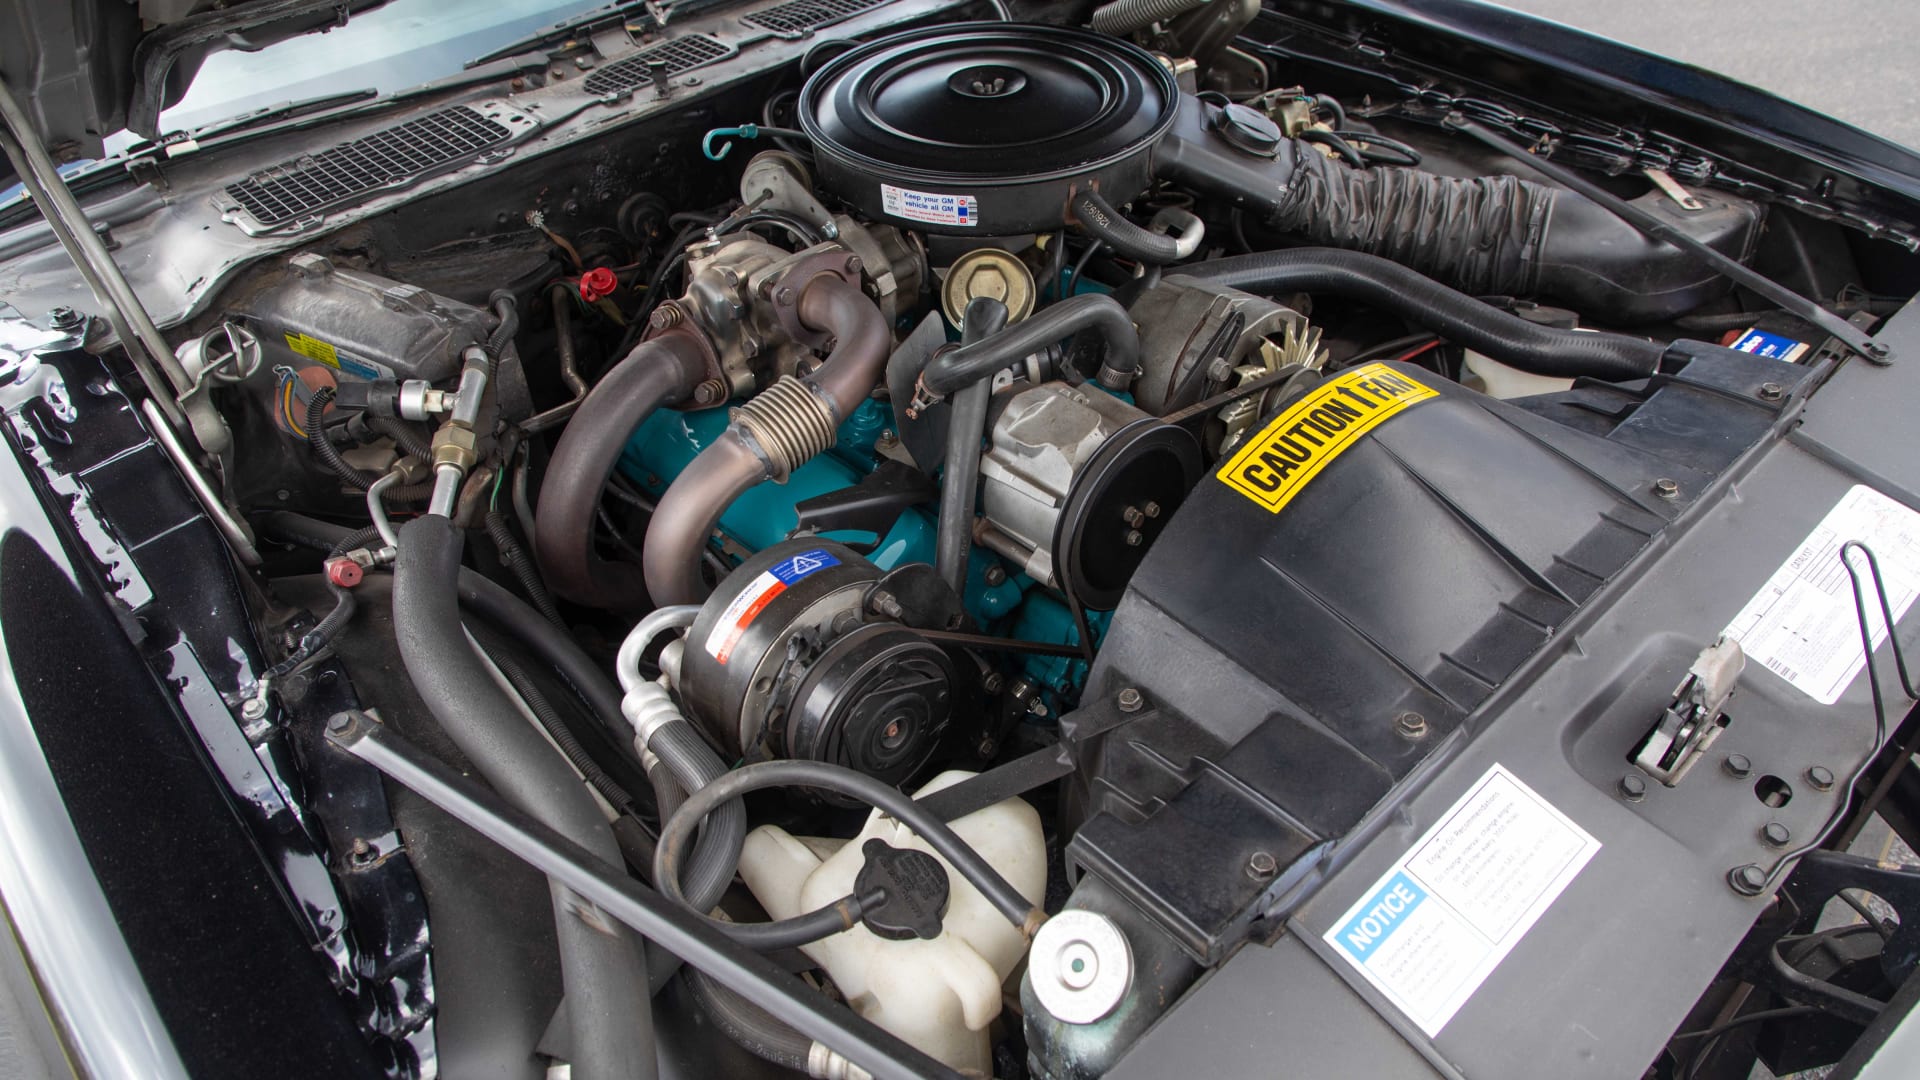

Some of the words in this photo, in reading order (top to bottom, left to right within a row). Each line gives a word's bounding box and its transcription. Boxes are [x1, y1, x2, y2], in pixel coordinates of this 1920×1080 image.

[904, 192, 921, 201] Keep
[905, 201, 928, 210] vehicle
[1242, 398, 1363, 492] CAUTION
[1357, 373, 1418, 401] FAN
[1790, 547, 1815, 570] CATALYST
[1452, 789, 1500, 837] Recommendations
[1347, 882, 1417, 952] NOTICE
